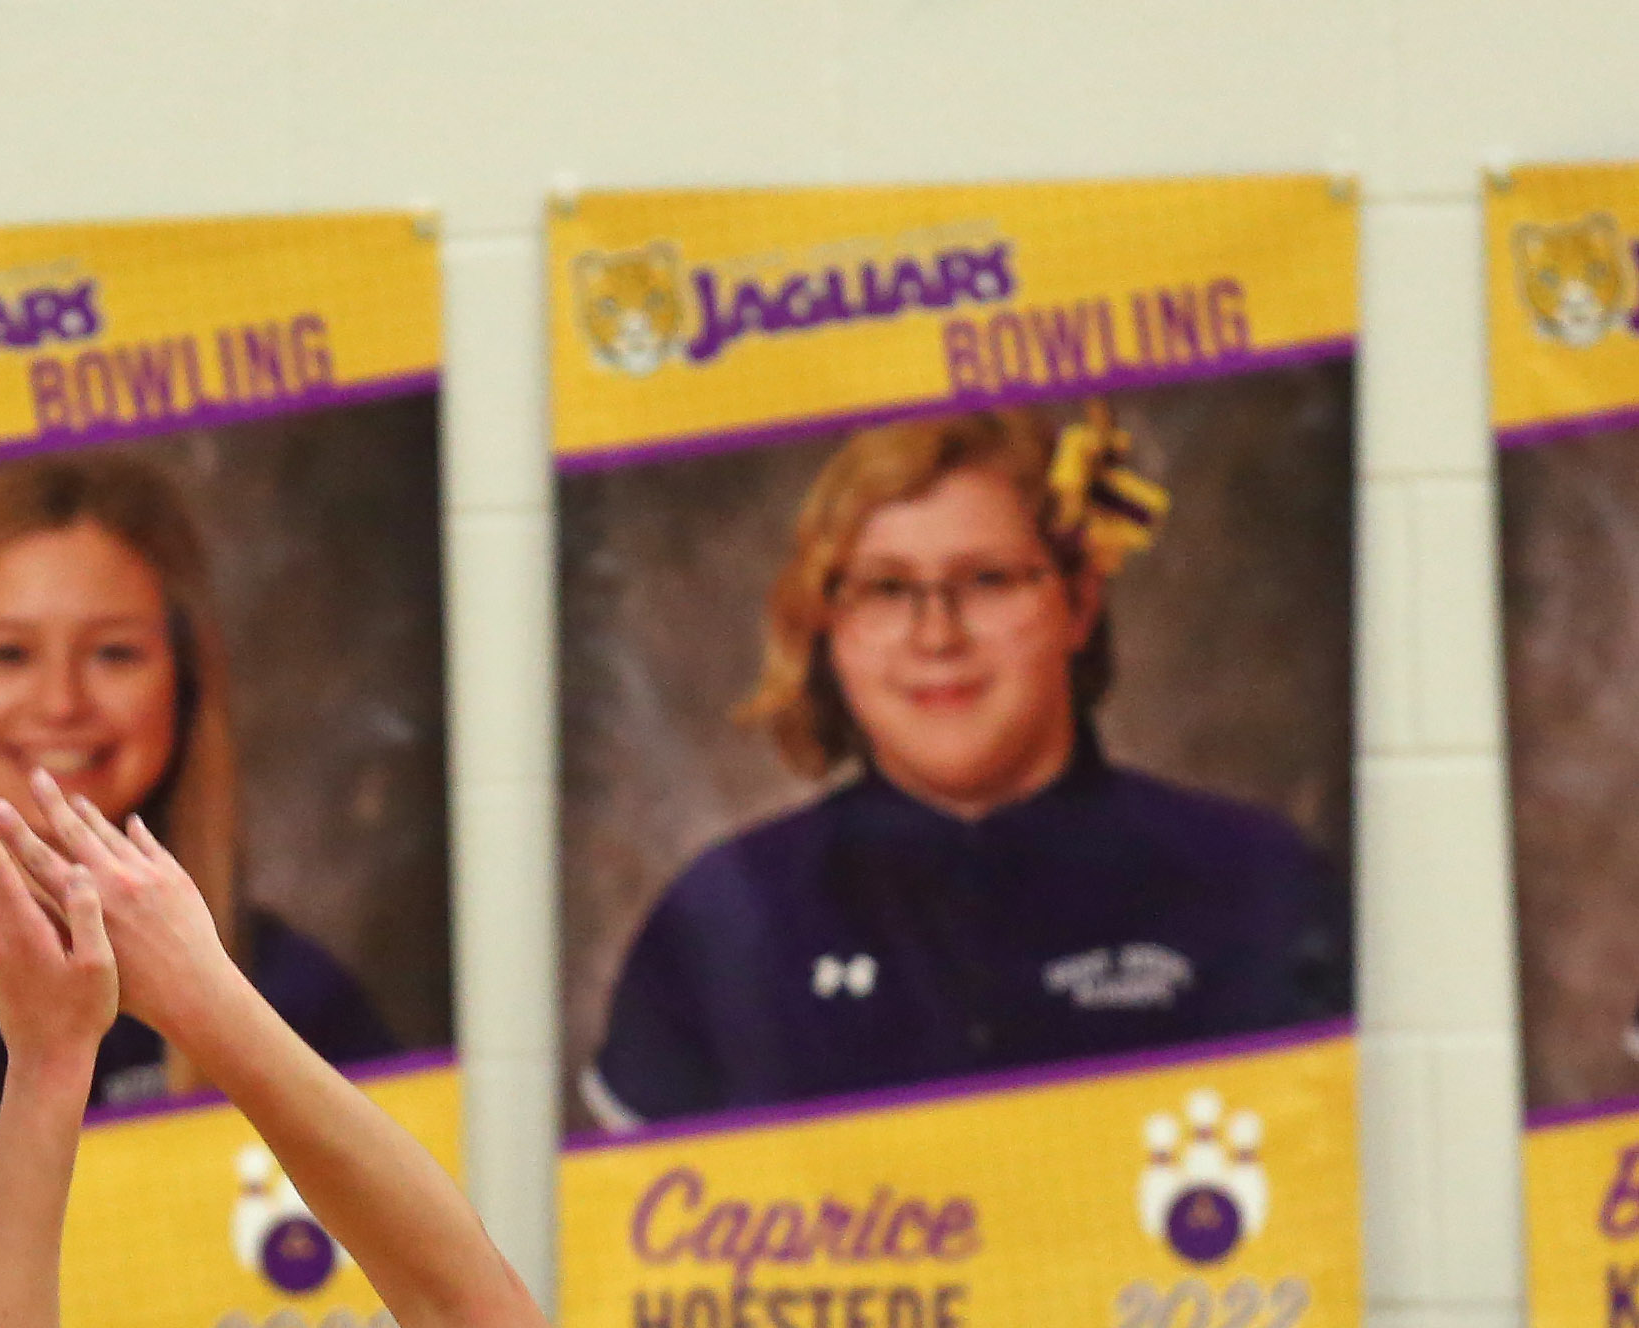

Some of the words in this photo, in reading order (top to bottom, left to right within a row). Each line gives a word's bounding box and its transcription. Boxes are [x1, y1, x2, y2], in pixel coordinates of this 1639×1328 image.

[687, 240, 1016, 365] JAGUARS
[942, 277, 1249, 396] BOWLING
[30, 312, 335, 434] BOWLING
[631, 1165, 983, 1298] Caprice
